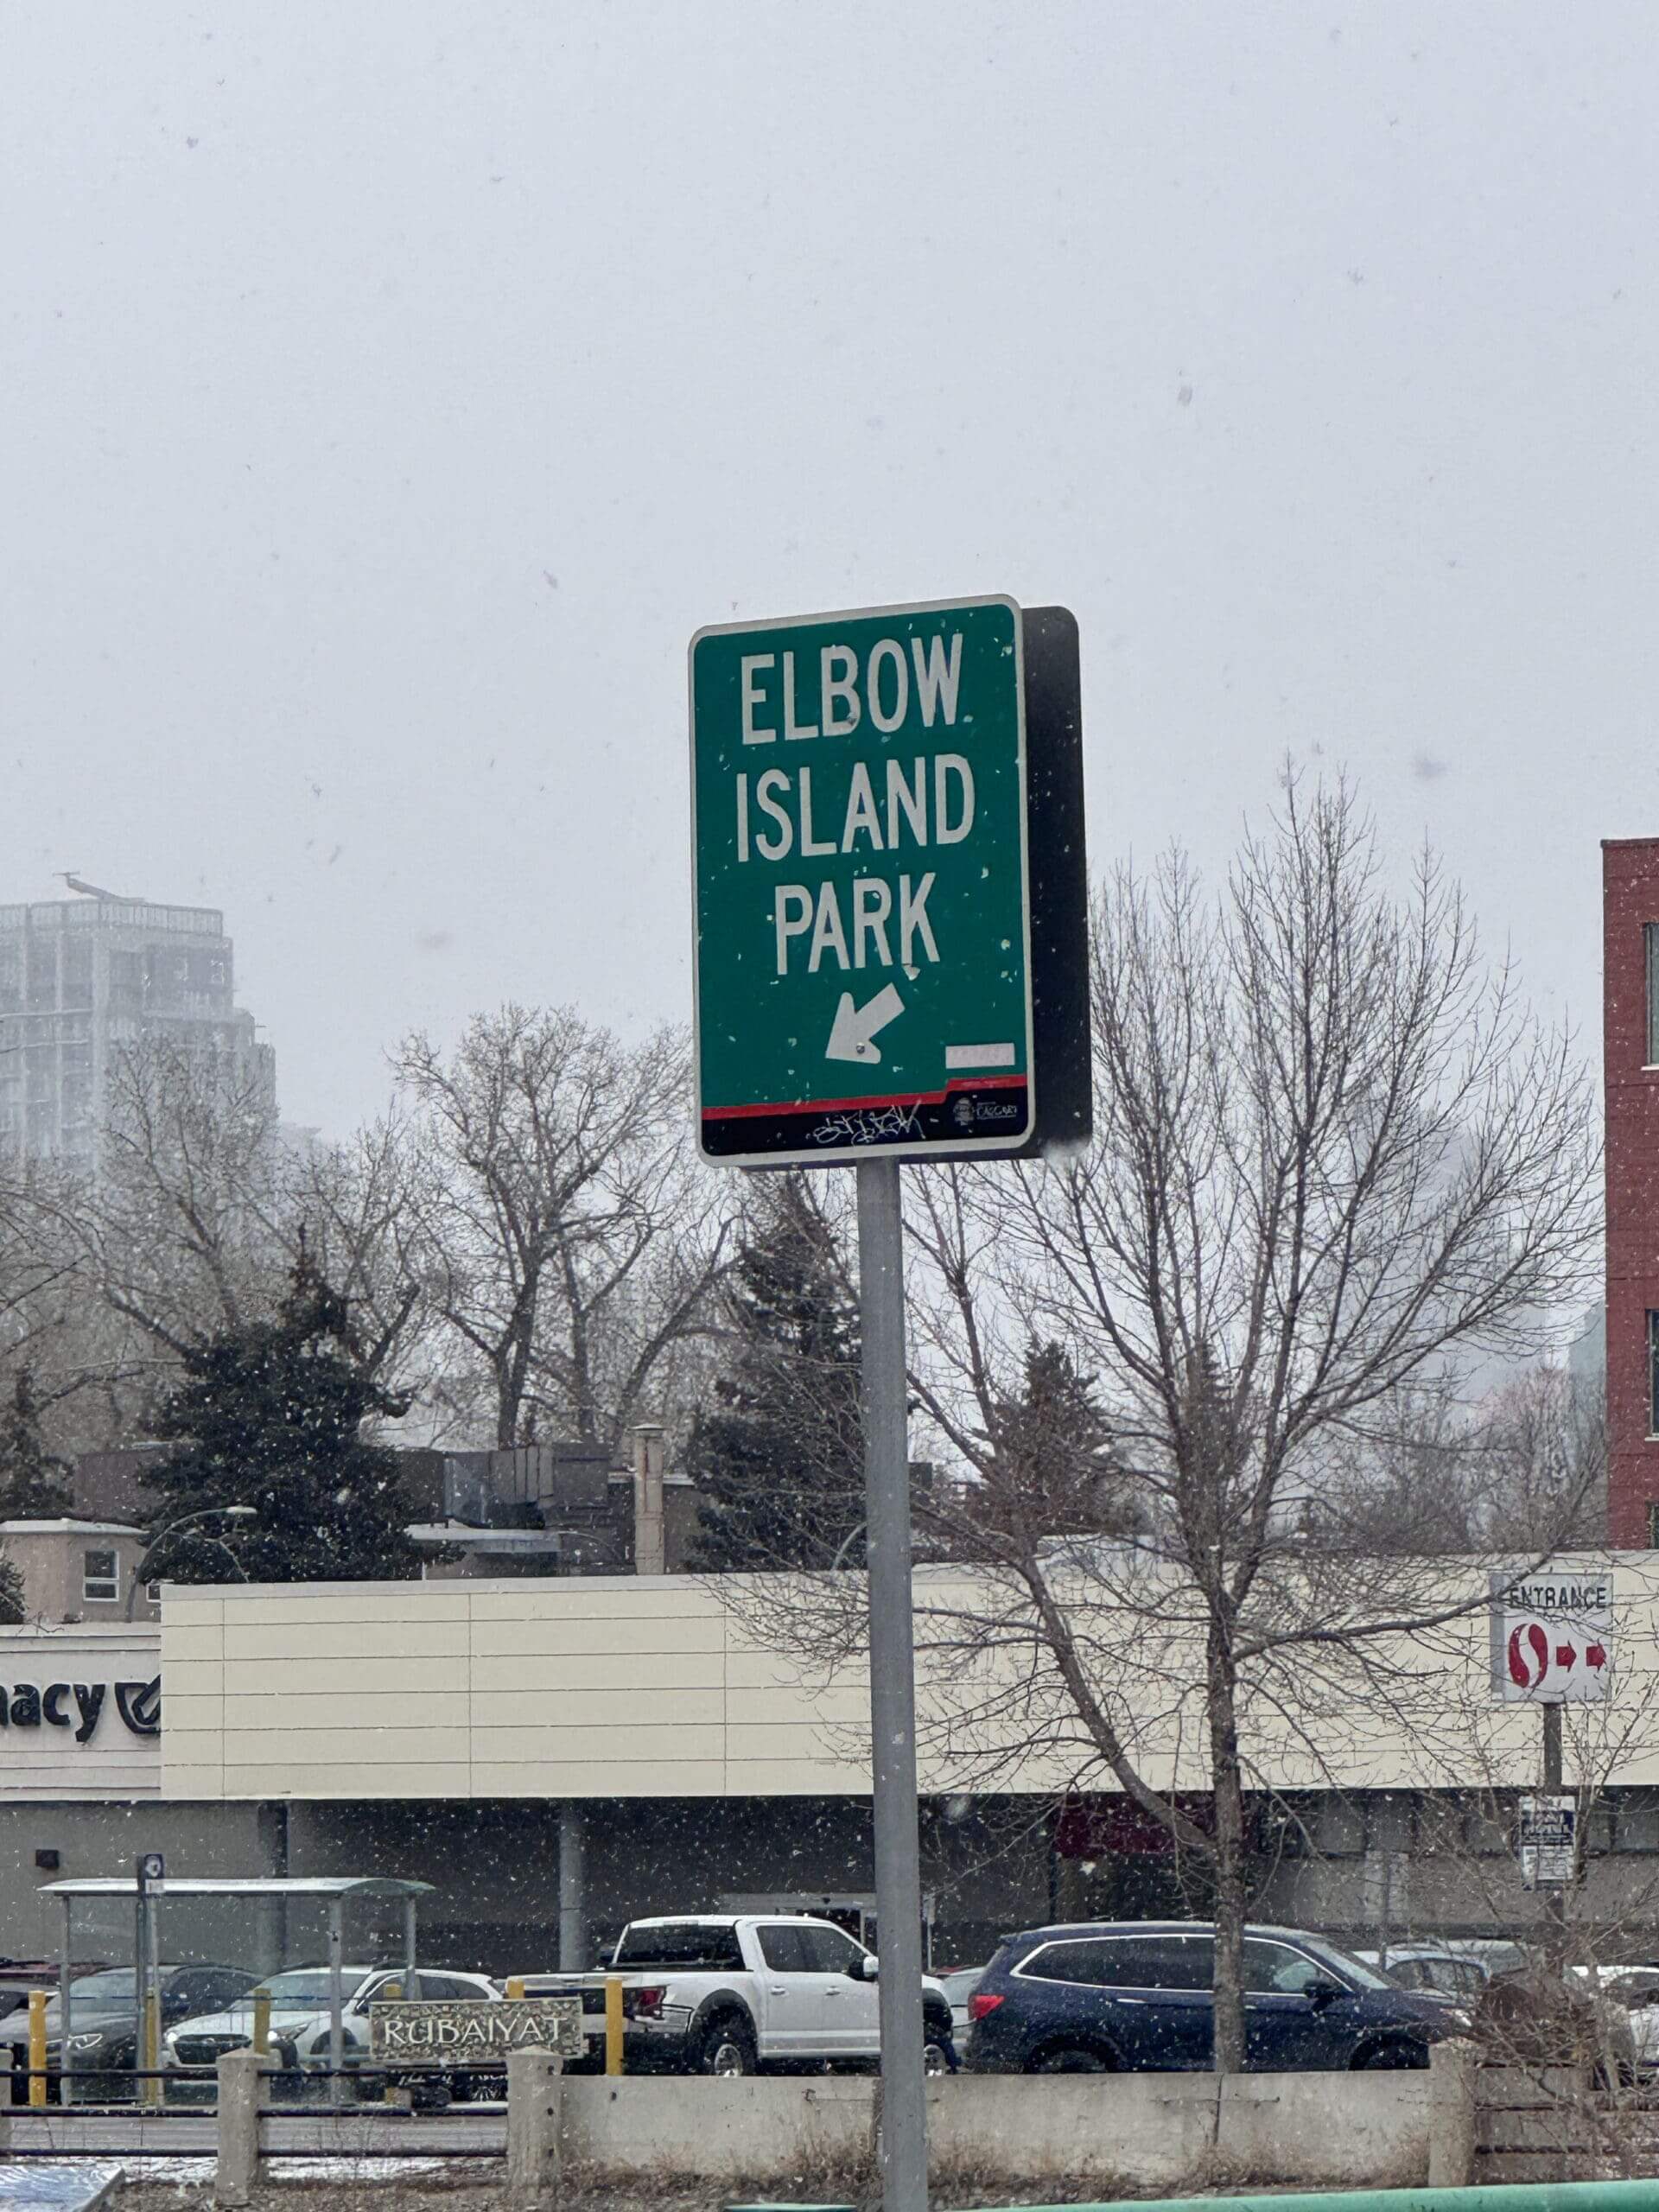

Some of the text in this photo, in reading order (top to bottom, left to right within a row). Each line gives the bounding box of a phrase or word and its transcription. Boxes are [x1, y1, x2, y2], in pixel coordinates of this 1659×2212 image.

[741, 633, 963, 745] ELBOW
[736, 753, 976, 862] ISLAND
[775, 872, 940, 976] PARK
[1510, 1586, 1606, 1609] ENTRANCE
[385, 2014, 567, 2044] RUBAIYAT
